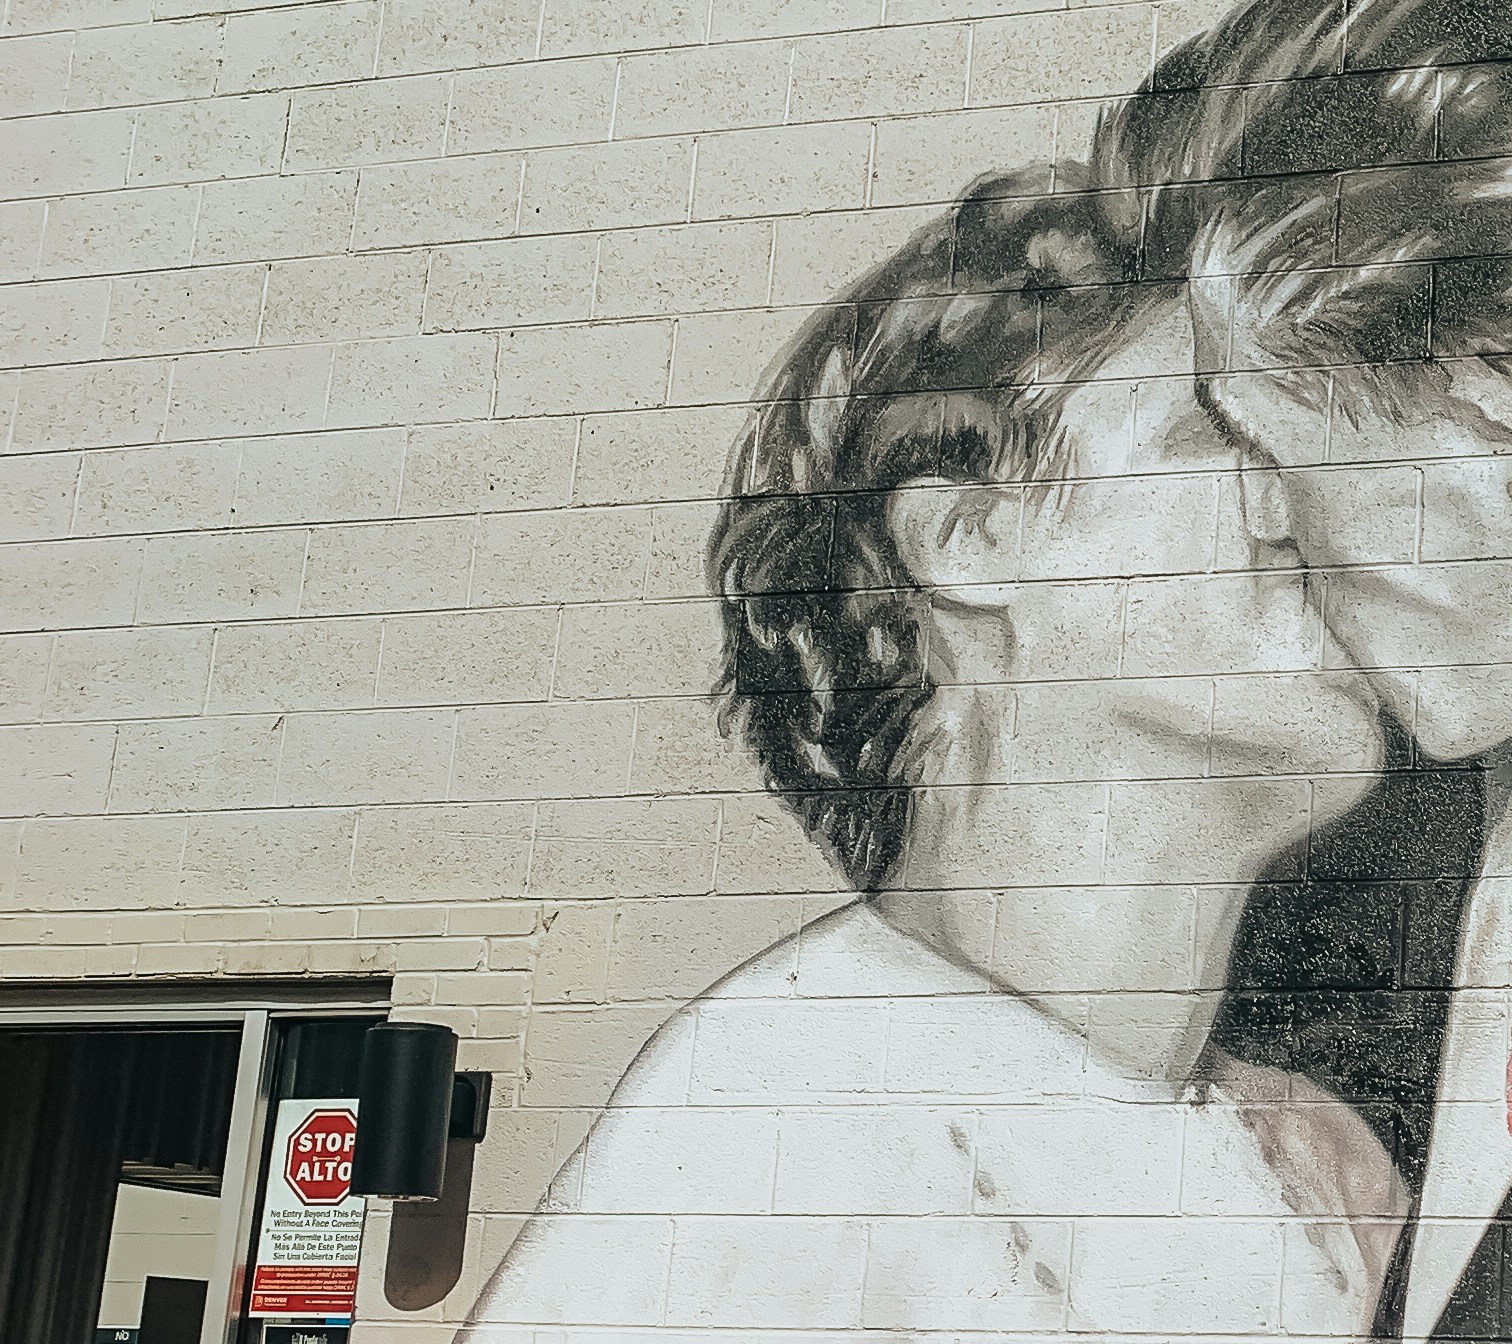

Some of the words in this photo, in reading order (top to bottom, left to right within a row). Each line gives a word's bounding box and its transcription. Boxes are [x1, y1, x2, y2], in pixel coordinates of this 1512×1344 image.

[297, 1132, 356, 1153] STOP
[295, 1161, 353, 1182] ALTO
[270, 1210, 281, 1218] No
[282, 1209, 302, 1219] Entry
[304, 1210, 331, 1220] Beyond
[333, 1210, 349, 1218] This
[351, 1210, 362, 1218] Poi
[274, 1219, 304, 1228] Without
[304, 1220, 310, 1228] A
[312, 1219, 330, 1228] Face
[271, 1234, 281, 1242] No
[283, 1233, 292, 1242] Se
[294, 1234, 322, 1242] Permite
[324, 1234, 332, 1242] La
[336, 1234, 360, 1242] Entrad
[306, 1242, 316, 1251] De
[318, 1243, 334, 1251] Este
[336, 1243, 358, 1252] Punto
[272, 1252, 285, 1260] Sin
[286, 1252, 300, 1260] Una
[302, 1252, 333, 1260] Cubierta
[336, 1252, 356, 1260] Facial
[114, 1330, 130, 1340] NO
